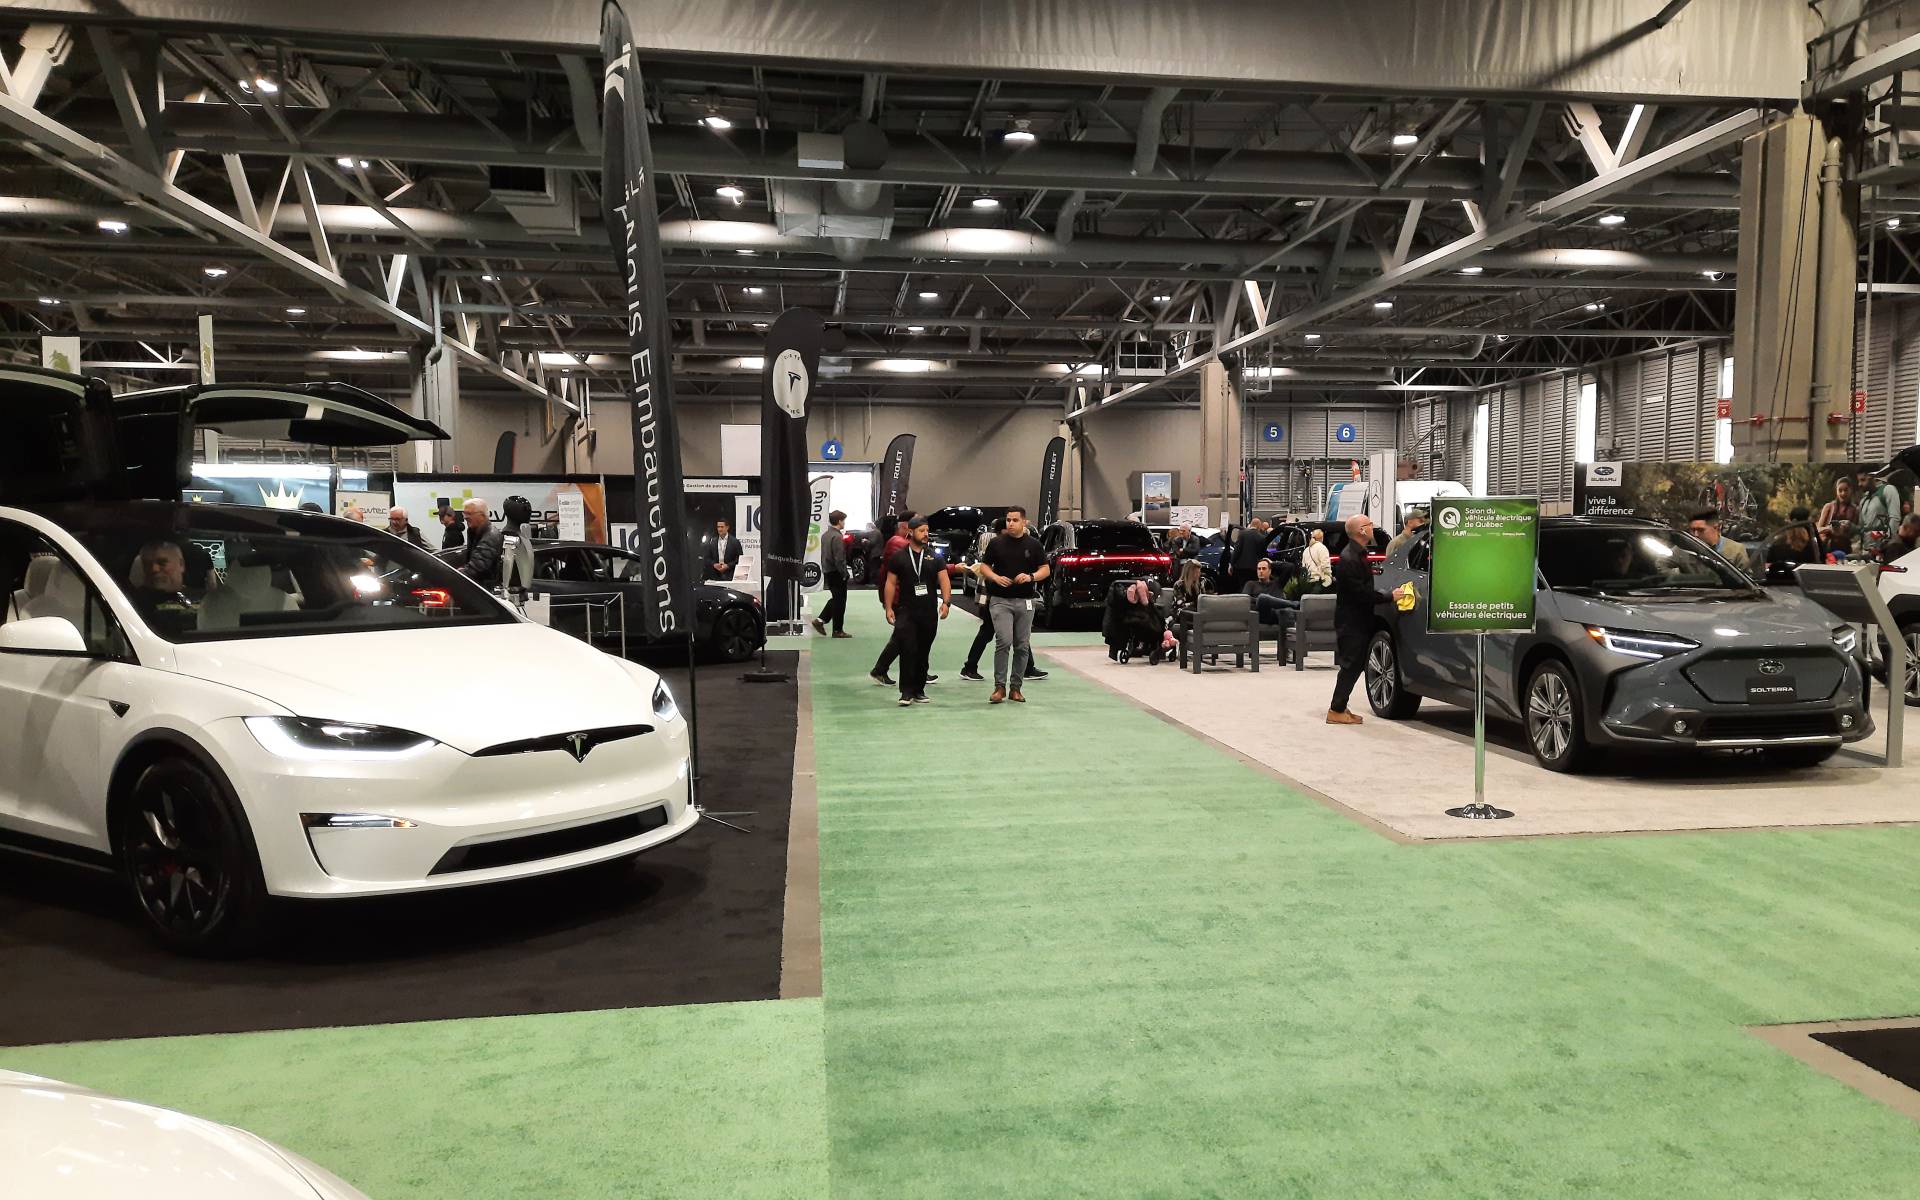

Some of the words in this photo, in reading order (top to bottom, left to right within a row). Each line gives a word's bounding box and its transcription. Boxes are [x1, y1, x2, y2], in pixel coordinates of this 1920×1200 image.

[1270, 426, 1278, 437] 5
[1342, 427, 1350, 438] 6
[827, 444, 837, 456] 4
[631, 348, 675, 633] Embauchons
[1588, 496, 1607, 505] vive
[1608, 495, 1616, 505] la
[1588, 506, 1634, 515] différence
[1496, 514, 1532, 522] électrique
[1449, 601, 1475, 610] Essais
[1476, 601, 1488, 610] de
[1489, 602, 1514, 612] petits
[1436, 611, 1477, 619] véhicules
[1479, 611, 1527, 620] électriques
